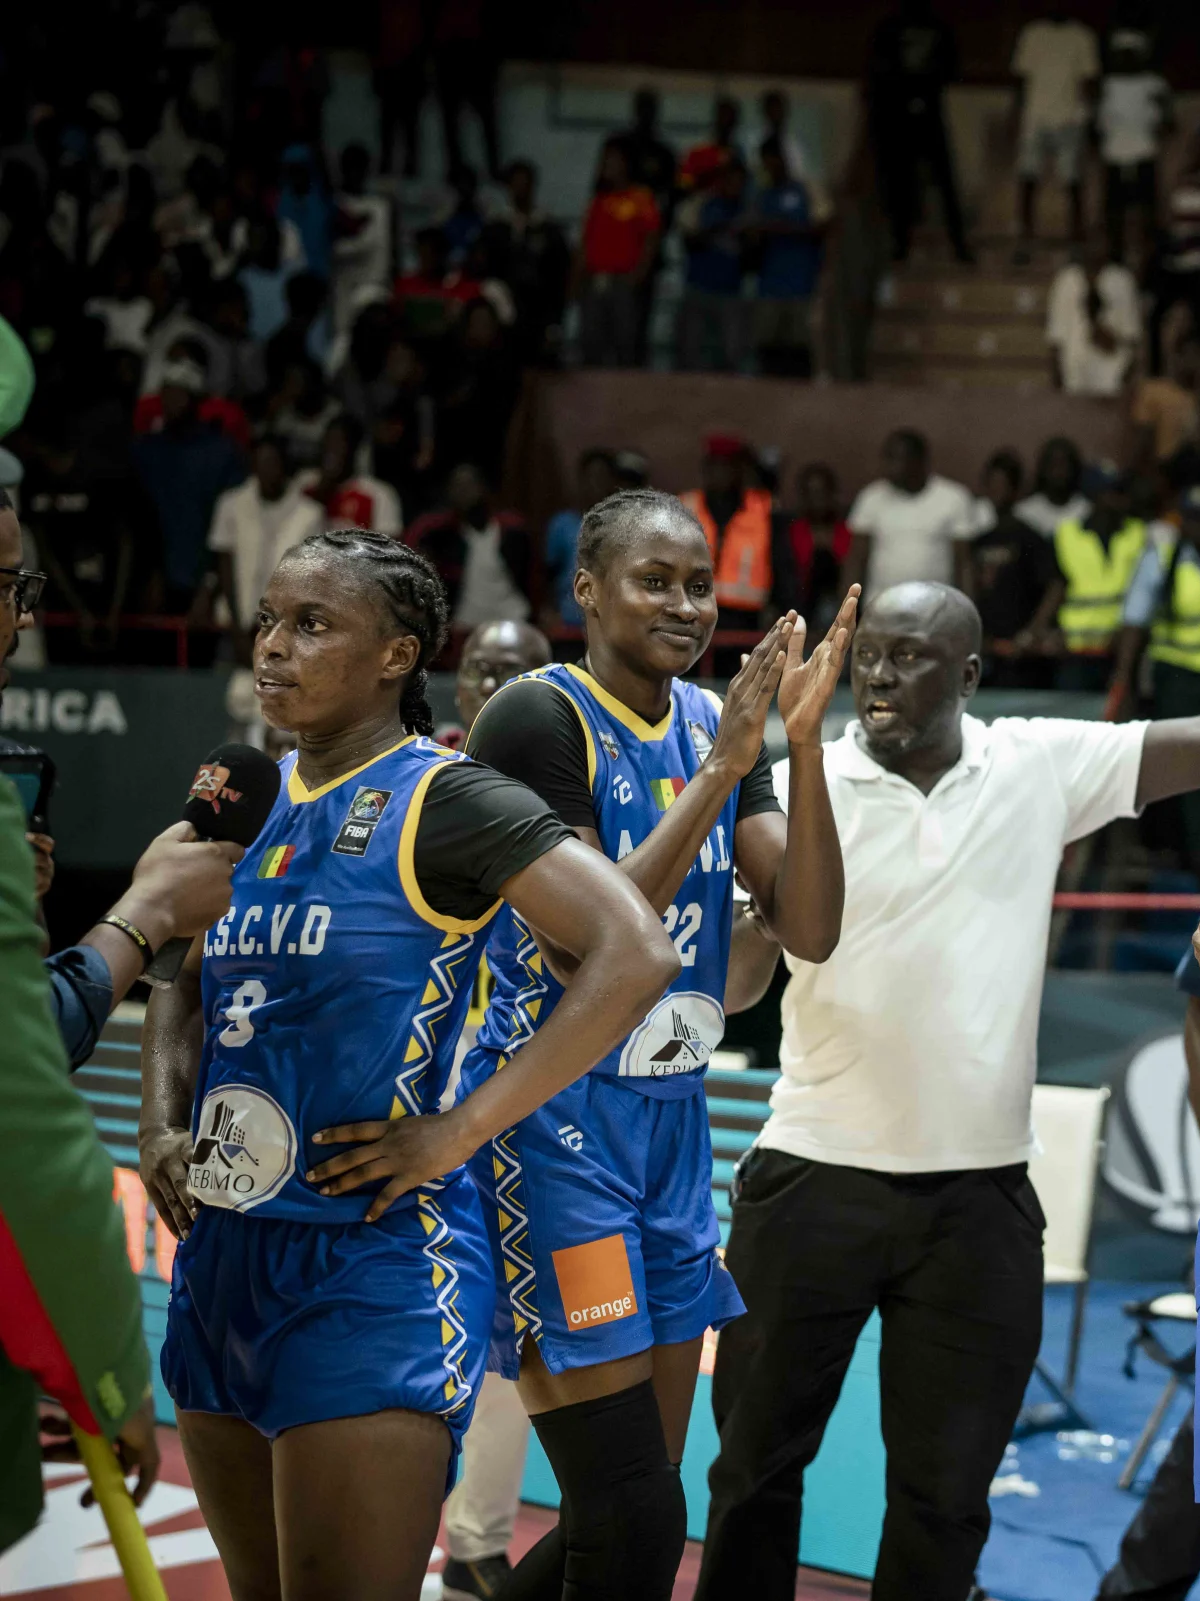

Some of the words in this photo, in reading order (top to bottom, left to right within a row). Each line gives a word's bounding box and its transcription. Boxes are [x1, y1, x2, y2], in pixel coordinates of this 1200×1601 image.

[344, 824, 370, 838] FIBA
[187, 1168, 255, 1193] KEBIMO
[570, 1296, 632, 1324] orange
